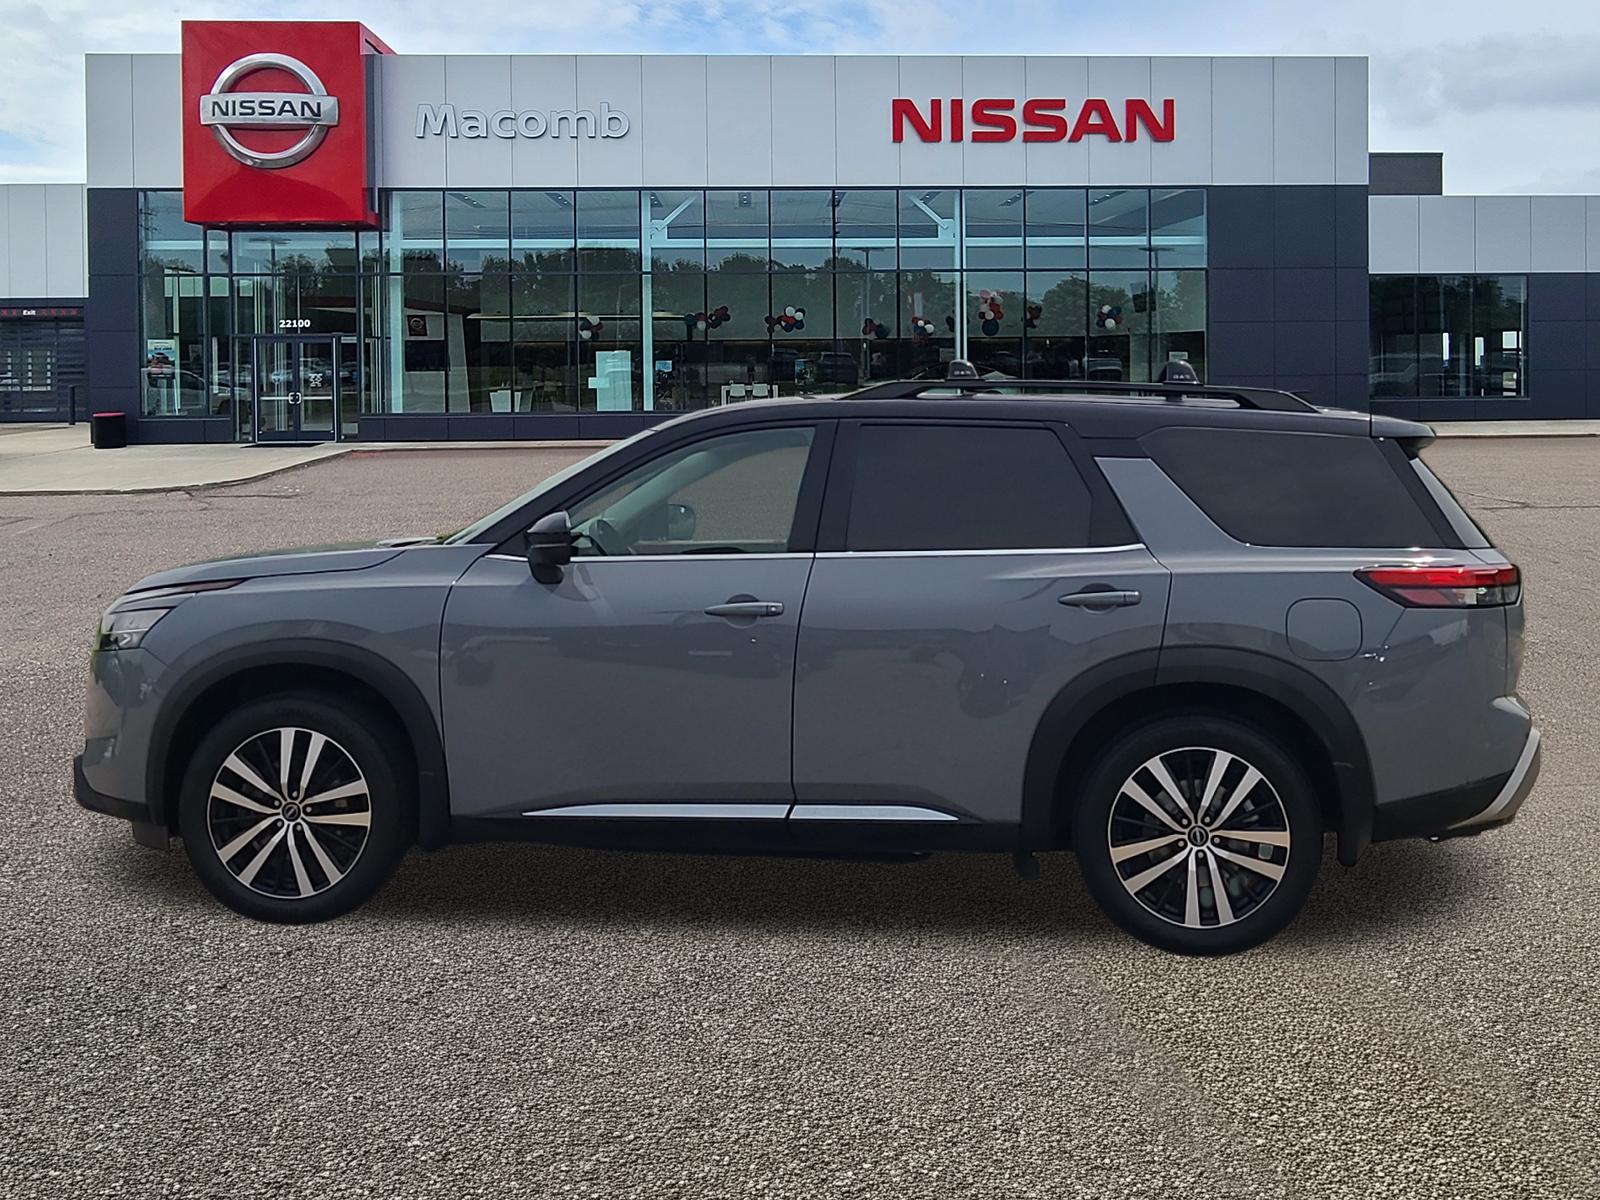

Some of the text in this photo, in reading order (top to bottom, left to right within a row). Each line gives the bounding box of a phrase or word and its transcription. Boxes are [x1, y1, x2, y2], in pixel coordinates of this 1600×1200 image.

[211, 99, 322, 117] NISSAN
[415, 101, 630, 138] Macomb
[892, 98, 1175, 142] NISSAN
[279, 319, 311, 328] 22100
